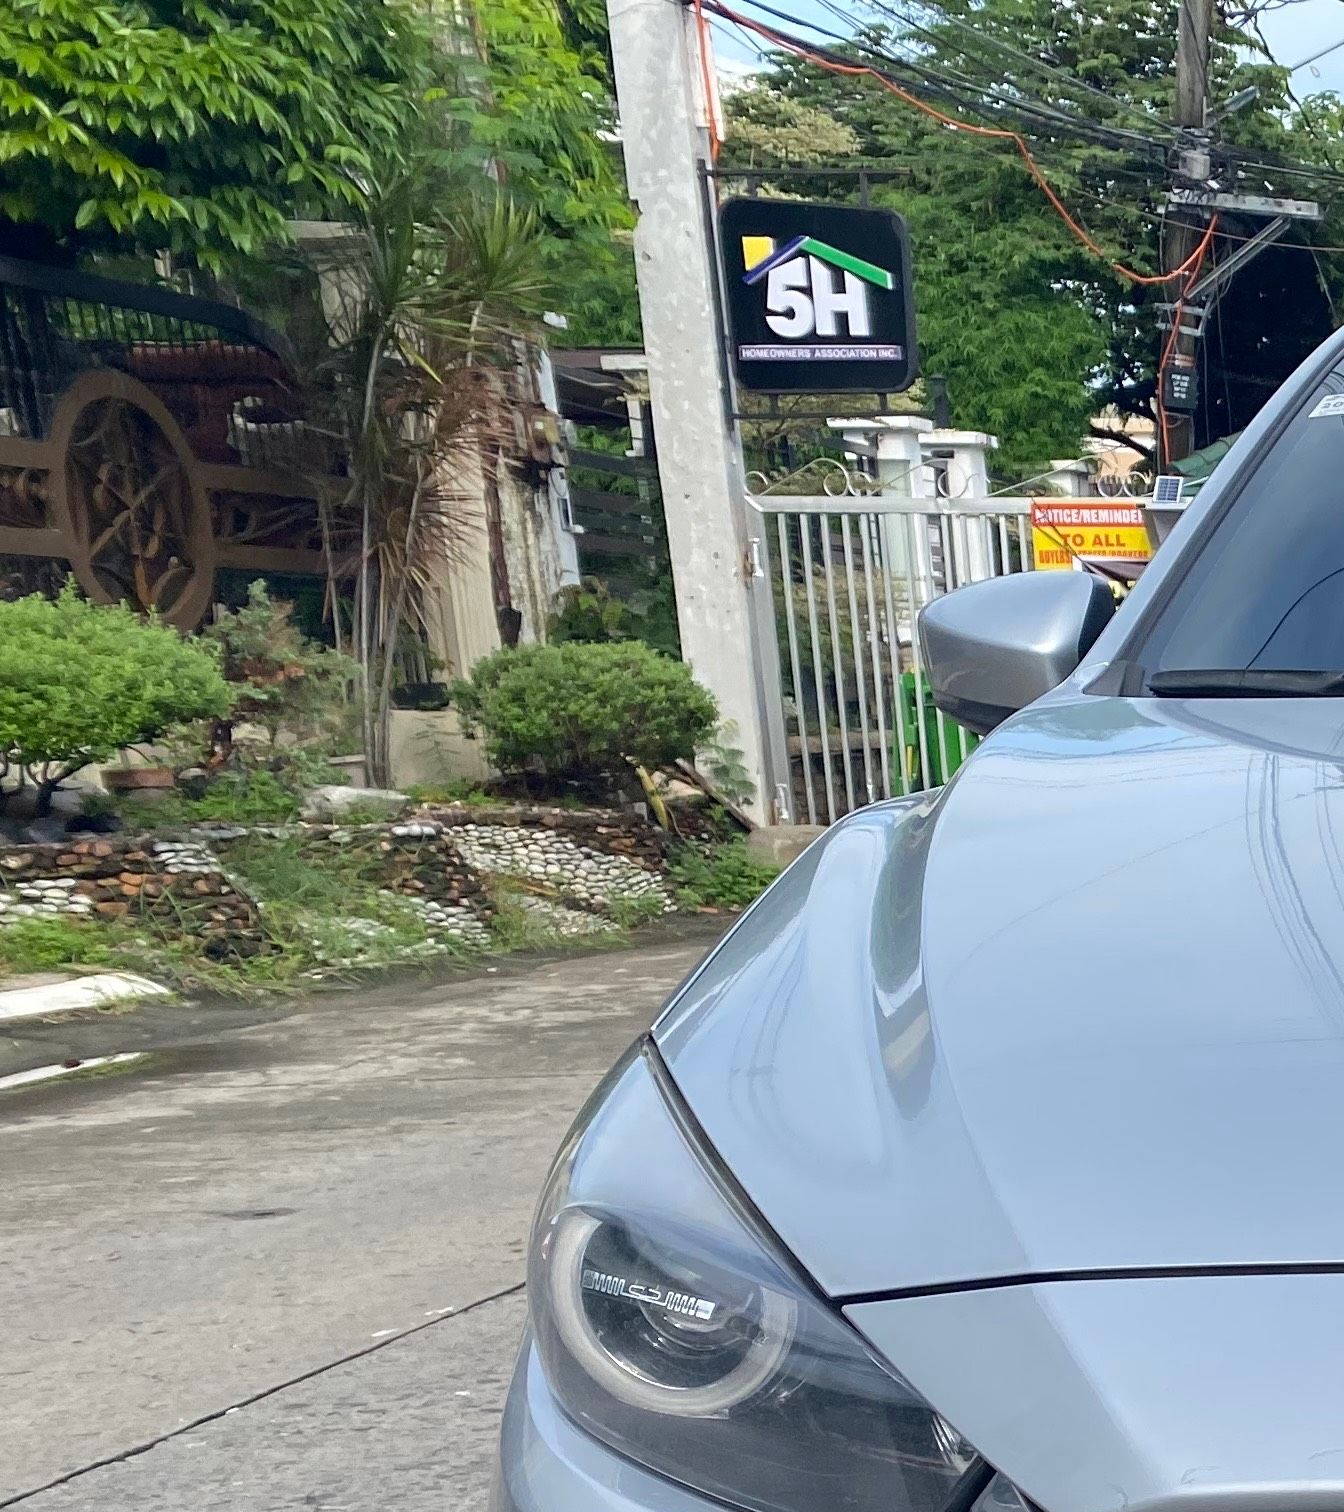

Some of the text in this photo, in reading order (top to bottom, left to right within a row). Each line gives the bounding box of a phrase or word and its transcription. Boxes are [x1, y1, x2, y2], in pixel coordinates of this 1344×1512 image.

[764, 255, 870, 339] 5H
[742, 349, 898, 359] HOMEOWNERS ASSOCIATION INC.
[1062, 534, 1126, 547] TO ALL
